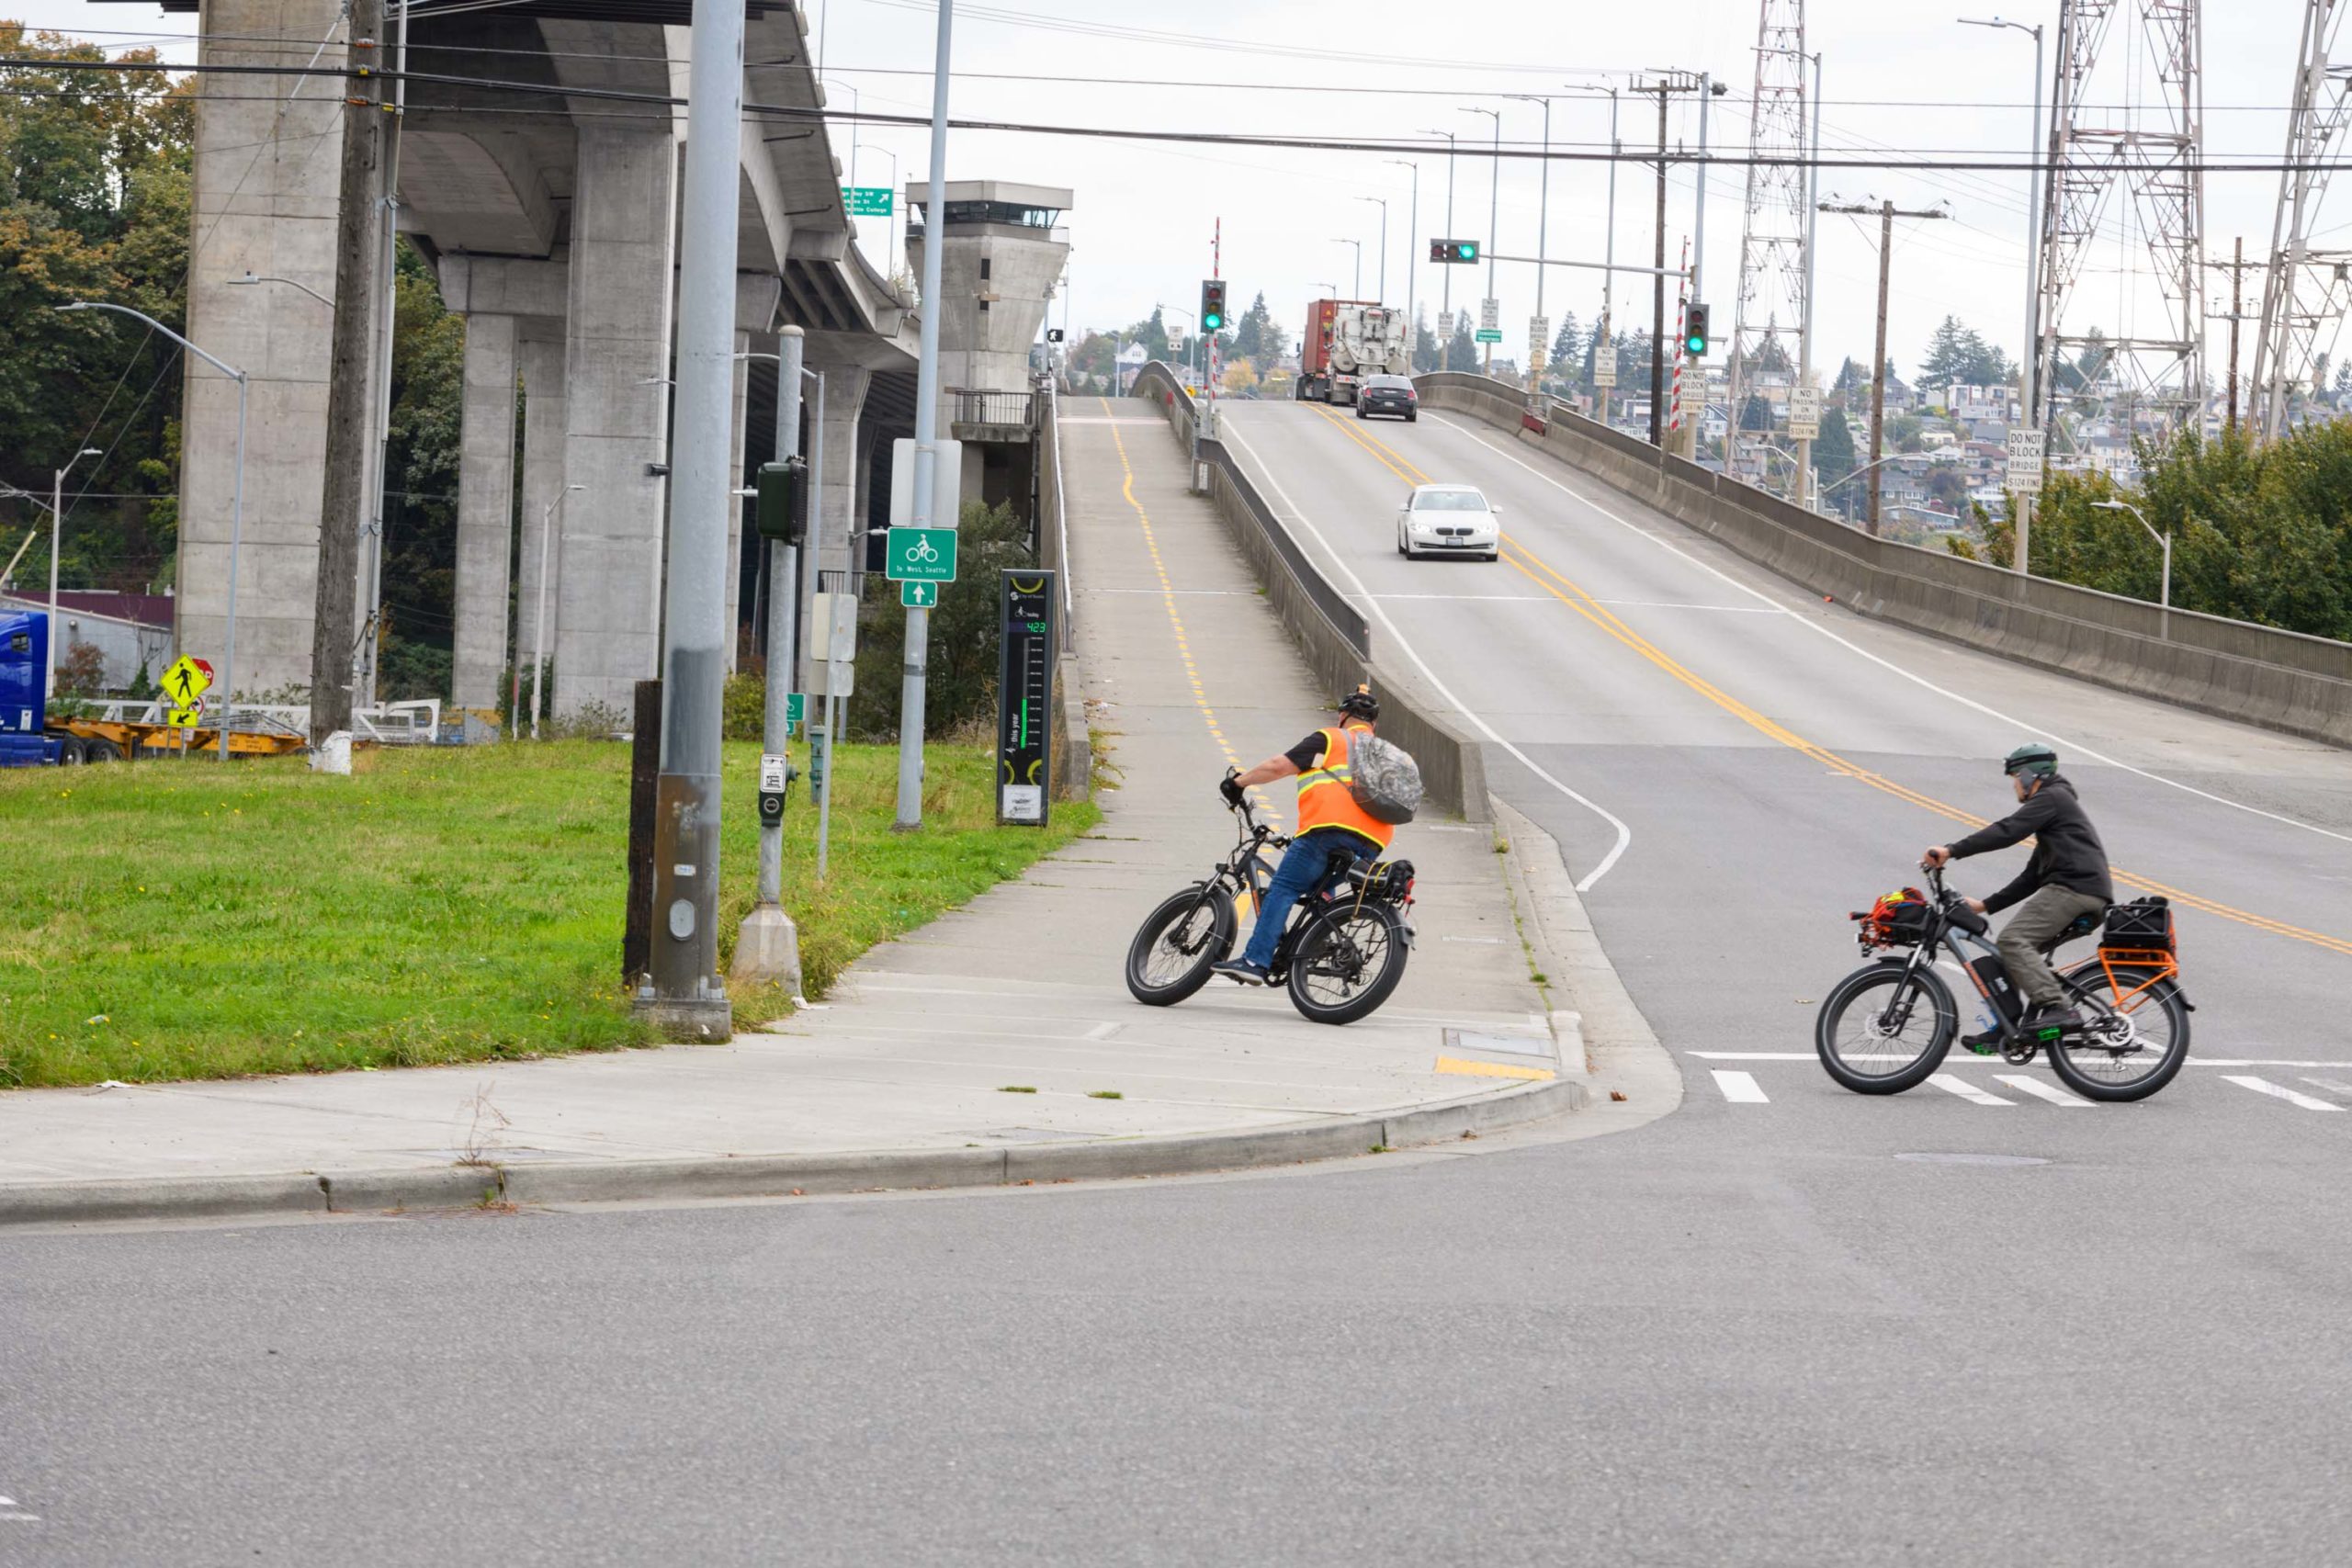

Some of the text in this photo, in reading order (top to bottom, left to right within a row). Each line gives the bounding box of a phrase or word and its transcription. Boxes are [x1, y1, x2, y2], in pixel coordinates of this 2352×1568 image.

[1682, 371, 1704, 380] DO NOT
[1800, 389, 1811, 398] NO
[2010, 433, 2041, 444] DO NOT
[2009, 446, 2041, 457] BLOCK
[2009, 460, 2040, 469] BRIDGE
[2008, 477, 2040, 488] $124 FINE
[1027, 622, 1046, 633] 423
[1011, 713, 1021, 742] this year
